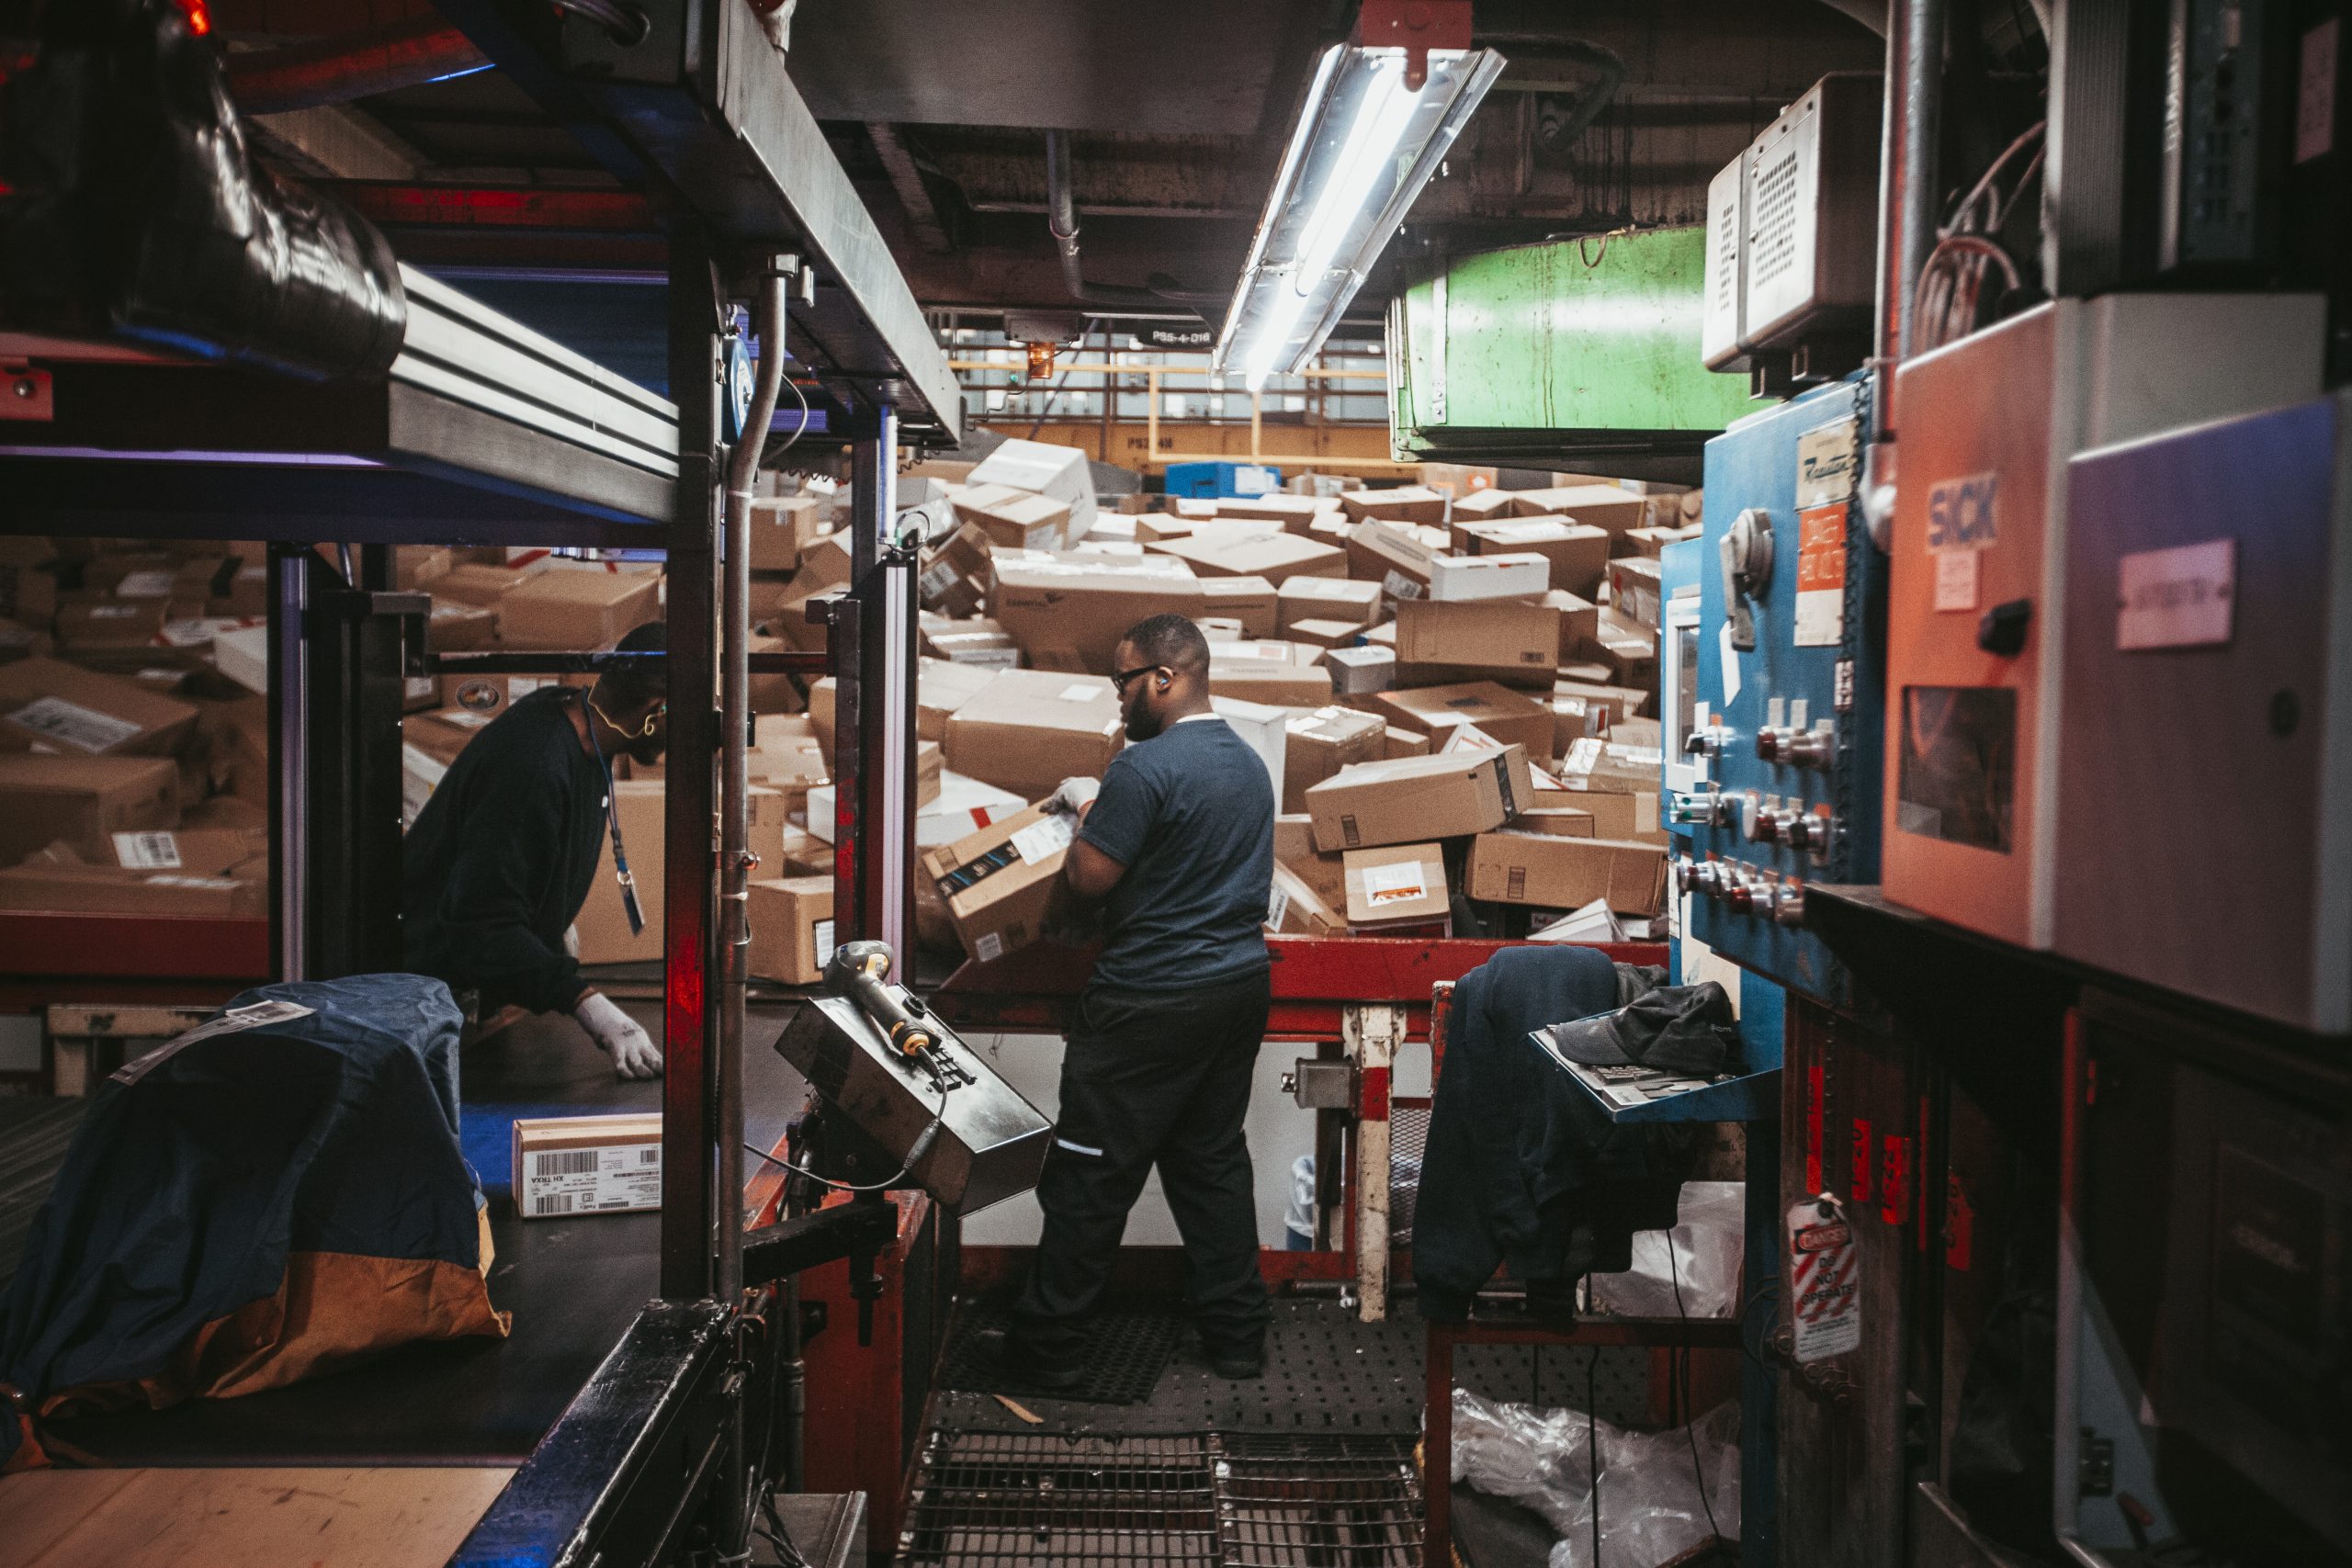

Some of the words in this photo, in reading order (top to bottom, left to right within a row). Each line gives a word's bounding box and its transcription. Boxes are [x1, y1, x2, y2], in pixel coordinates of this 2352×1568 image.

[1930, 478, 1997, 546] SICK
[1819, 1256, 1837, 1268] DO
[1816, 1271, 1839, 1286] NOT
[1801, 1283, 1854, 1305] OPERATE
